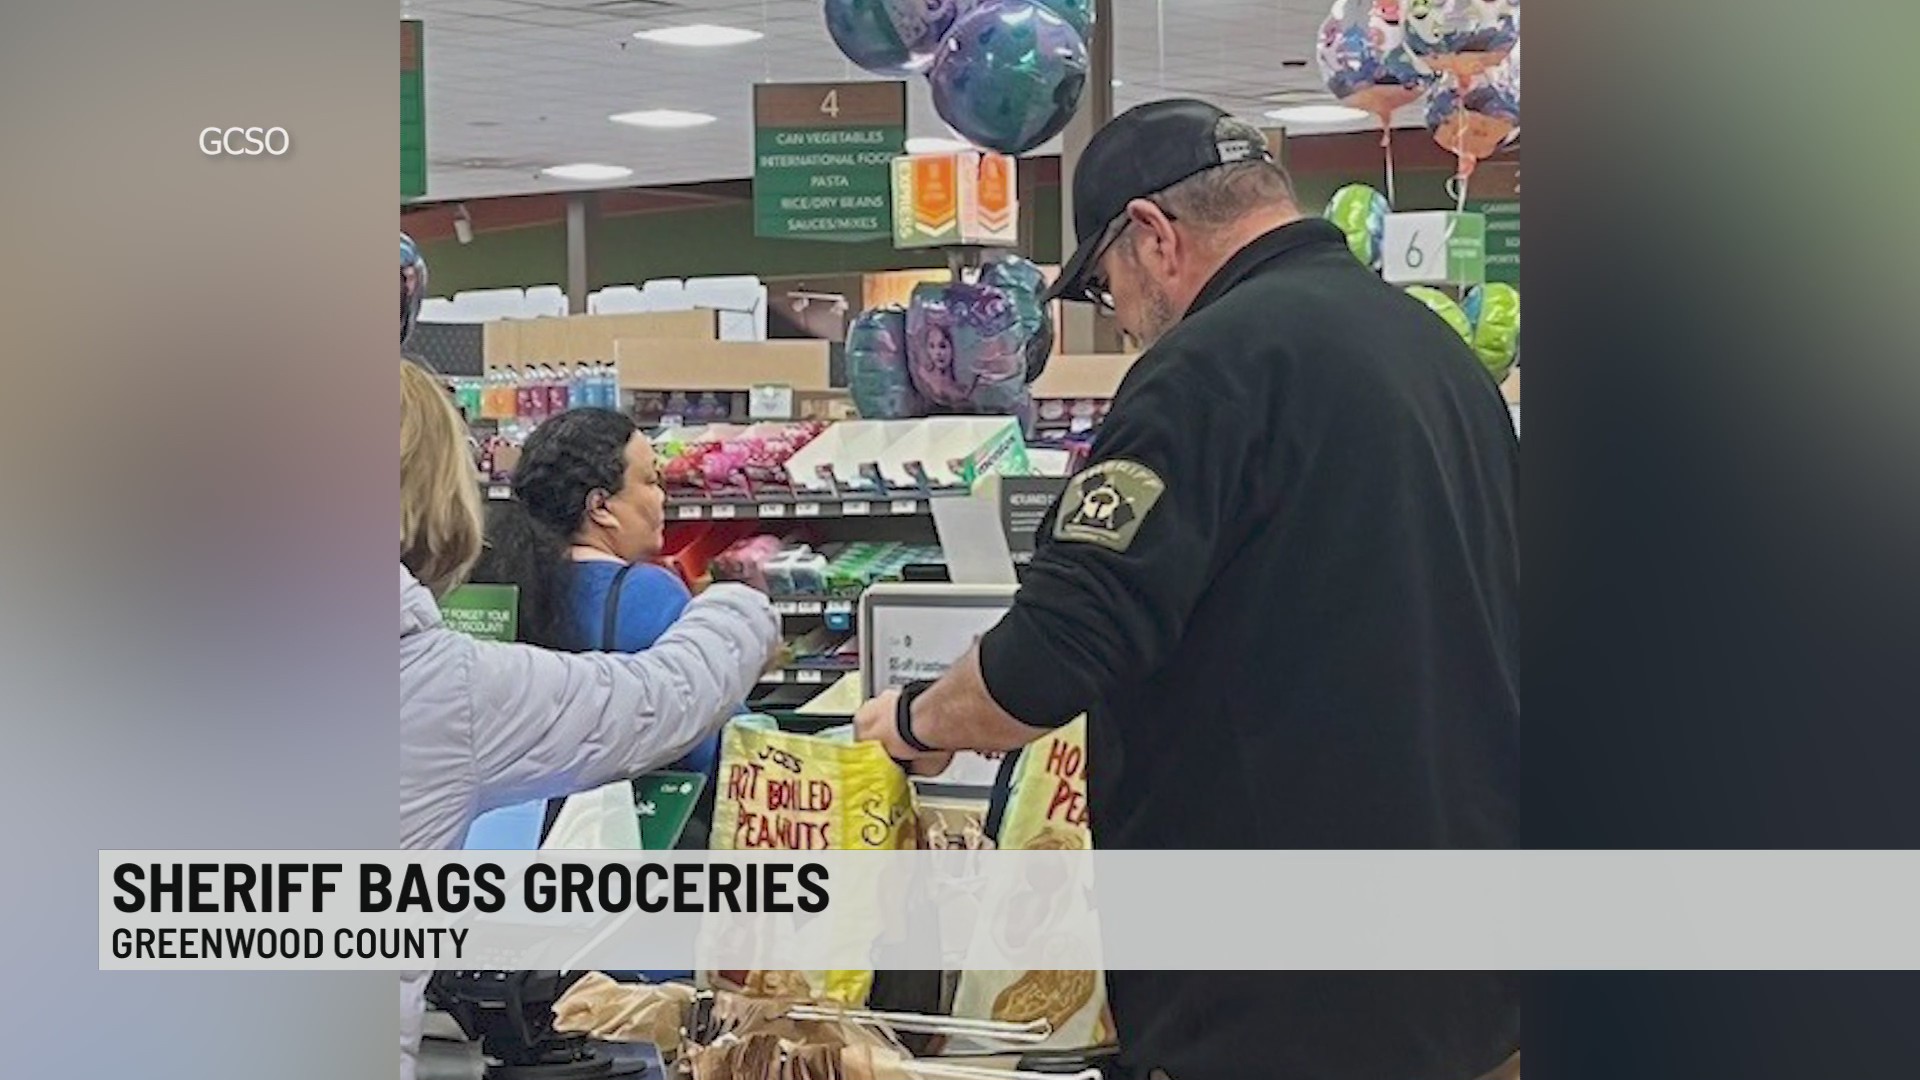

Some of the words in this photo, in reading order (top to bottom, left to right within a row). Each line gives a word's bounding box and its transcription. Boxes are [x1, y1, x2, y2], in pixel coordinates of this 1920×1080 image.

[819, 88, 840, 118] 4
[775, 132, 804, 146] CAN
[806, 130, 884, 145] VEGETABLES
[760, 153, 856, 168] INTERNATIONAL
[810, 174, 849, 188] PASTA
[780, 196, 837, 210] RICE/DRY
[840, 195, 884, 209] BEANS
[786, 217, 878, 232] SAUCES/MIXES
[1404, 229, 1425, 269] 6
[487, 608, 511, 621] YOUR
[1046, 738, 1087, 780] HO
[767, 778, 833, 812] BOILED
[734, 801, 831, 849] PEANUTS
